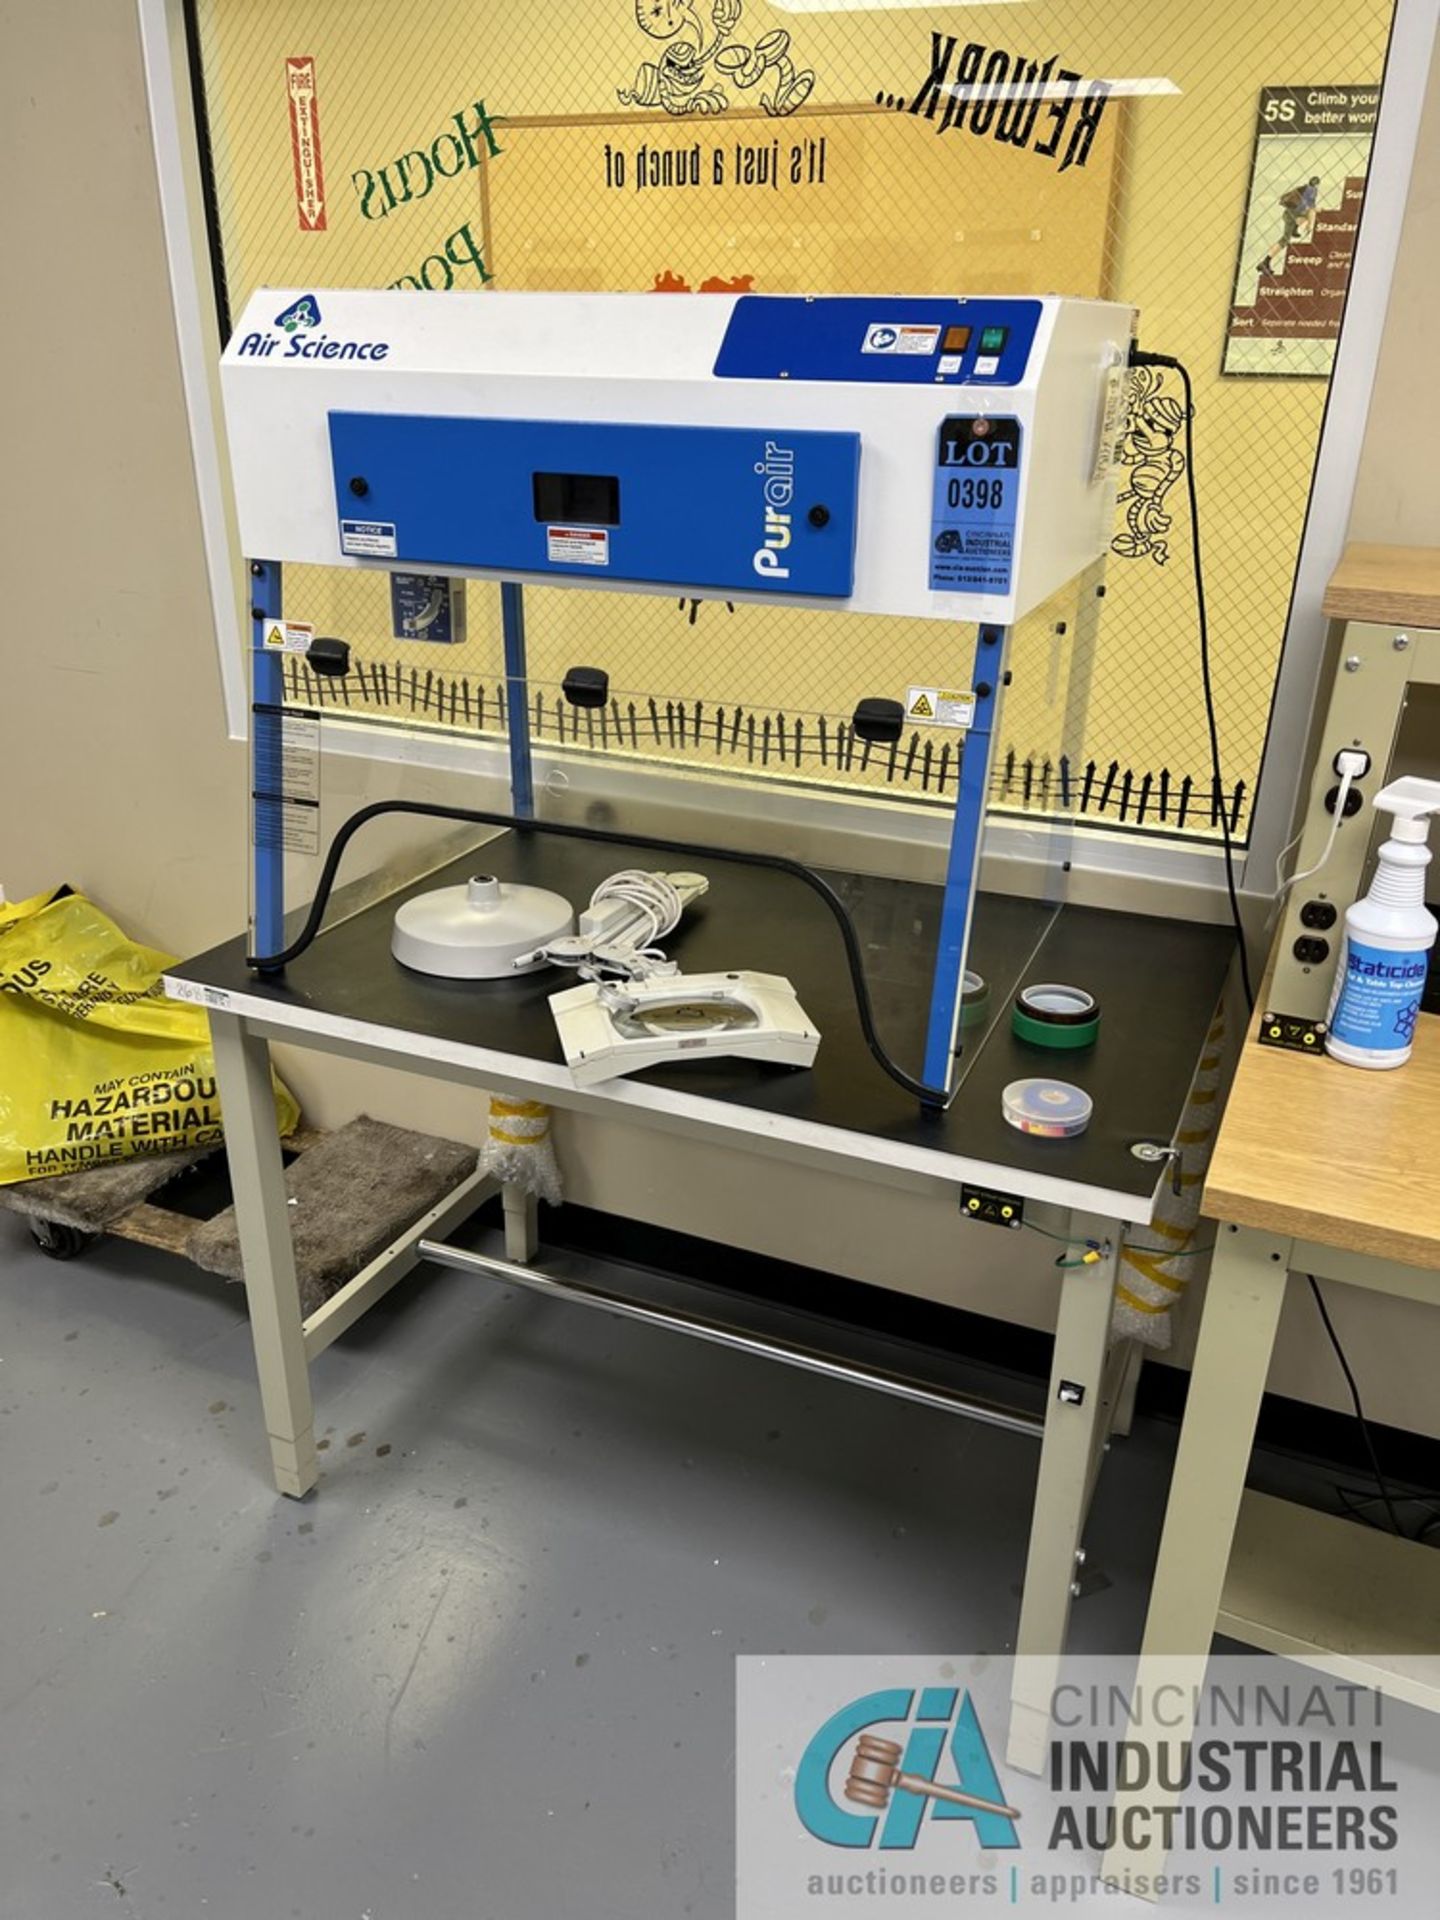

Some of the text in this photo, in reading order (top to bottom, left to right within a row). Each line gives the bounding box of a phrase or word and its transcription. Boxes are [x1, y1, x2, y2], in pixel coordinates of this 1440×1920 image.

[1264, 99, 1297, 122] 5S
[1307, 91, 1347, 106] Climb
[1304, 111, 1345, 124] better
[298, 96, 316, 219] EXTINGUISHER
[1287, 255, 1323, 267] Sweep
[1259, 287, 1314, 299] Straighten
[1232, 316, 1255, 328] Sort
[238, 332, 389, 362] Air Science
[945, 441, 1012, 466] LOT
[948, 478, 1003, 509] 0398
[94, 1063, 195, 1095] MAY CONTAIN
[26, 1140, 123, 1166] HANDLE
[131, 1133, 188, 1154] WITH
